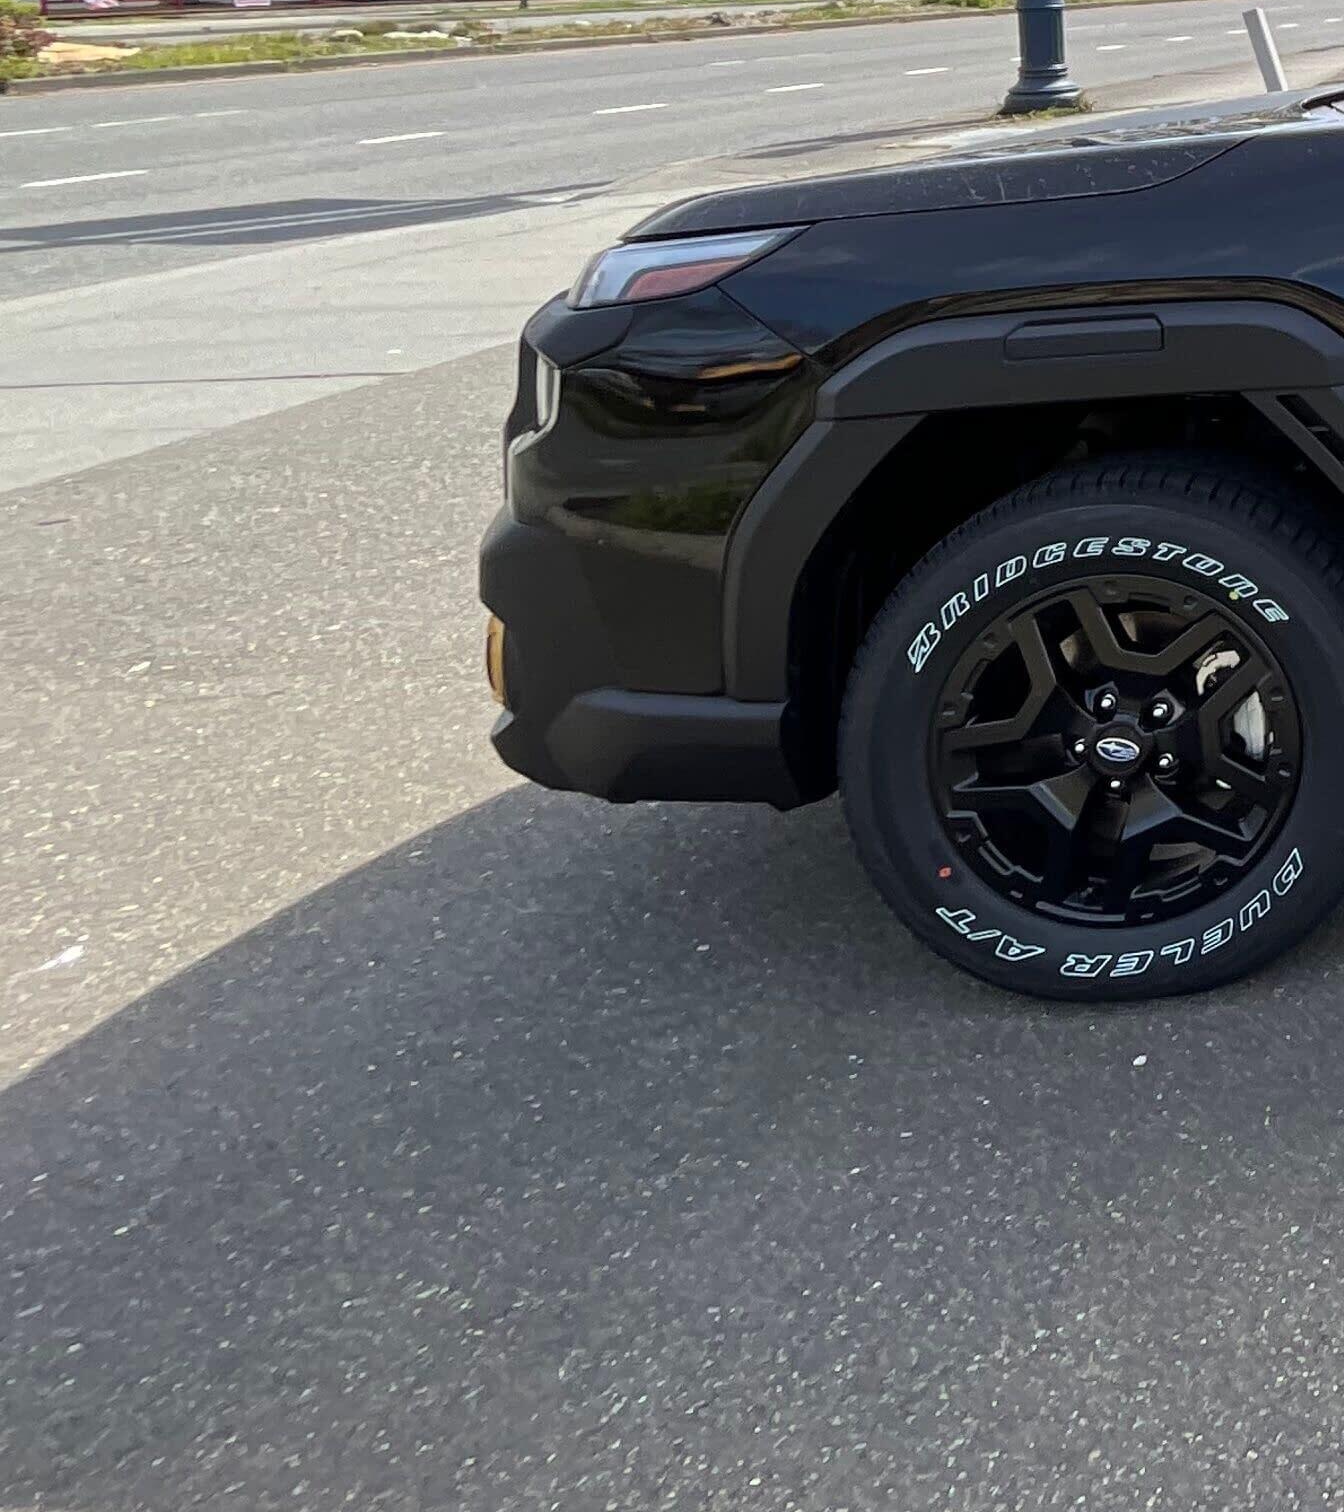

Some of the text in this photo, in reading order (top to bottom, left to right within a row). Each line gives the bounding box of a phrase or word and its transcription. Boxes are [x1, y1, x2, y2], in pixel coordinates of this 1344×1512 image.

[907, 536, 1290, 675] BRIDGESTONE
[936, 847, 1303, 978] DUELER A/T
